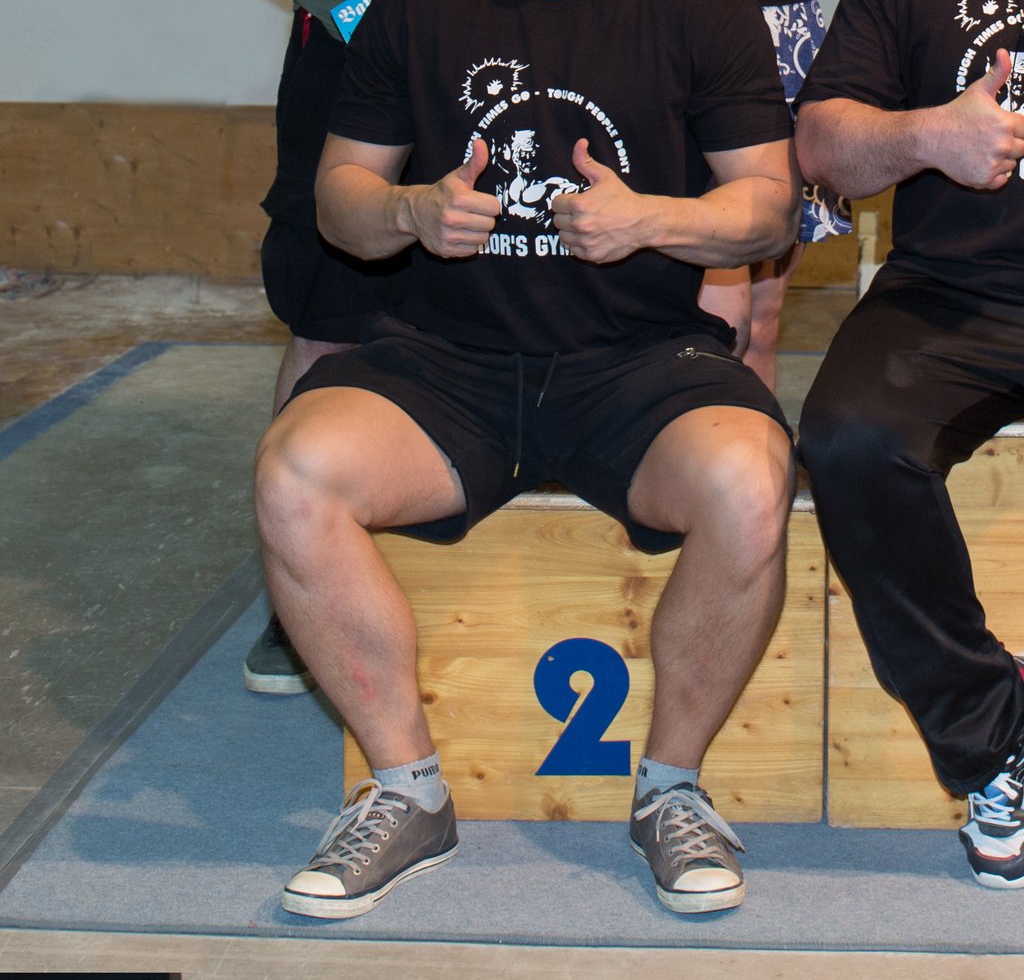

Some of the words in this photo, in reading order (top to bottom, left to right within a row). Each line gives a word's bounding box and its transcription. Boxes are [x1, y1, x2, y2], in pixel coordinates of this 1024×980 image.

[956, 48, 977, 93] TOUGH
[973, 20, 1005, 47] TIMES
[478, 100, 508, 130] TIMES
[511, 91, 530, 104] GO
[547, 88, 584, 105] TOUGH
[585, 101, 618, 138] PEOPLE
[533, 637, 631, 775] 2
